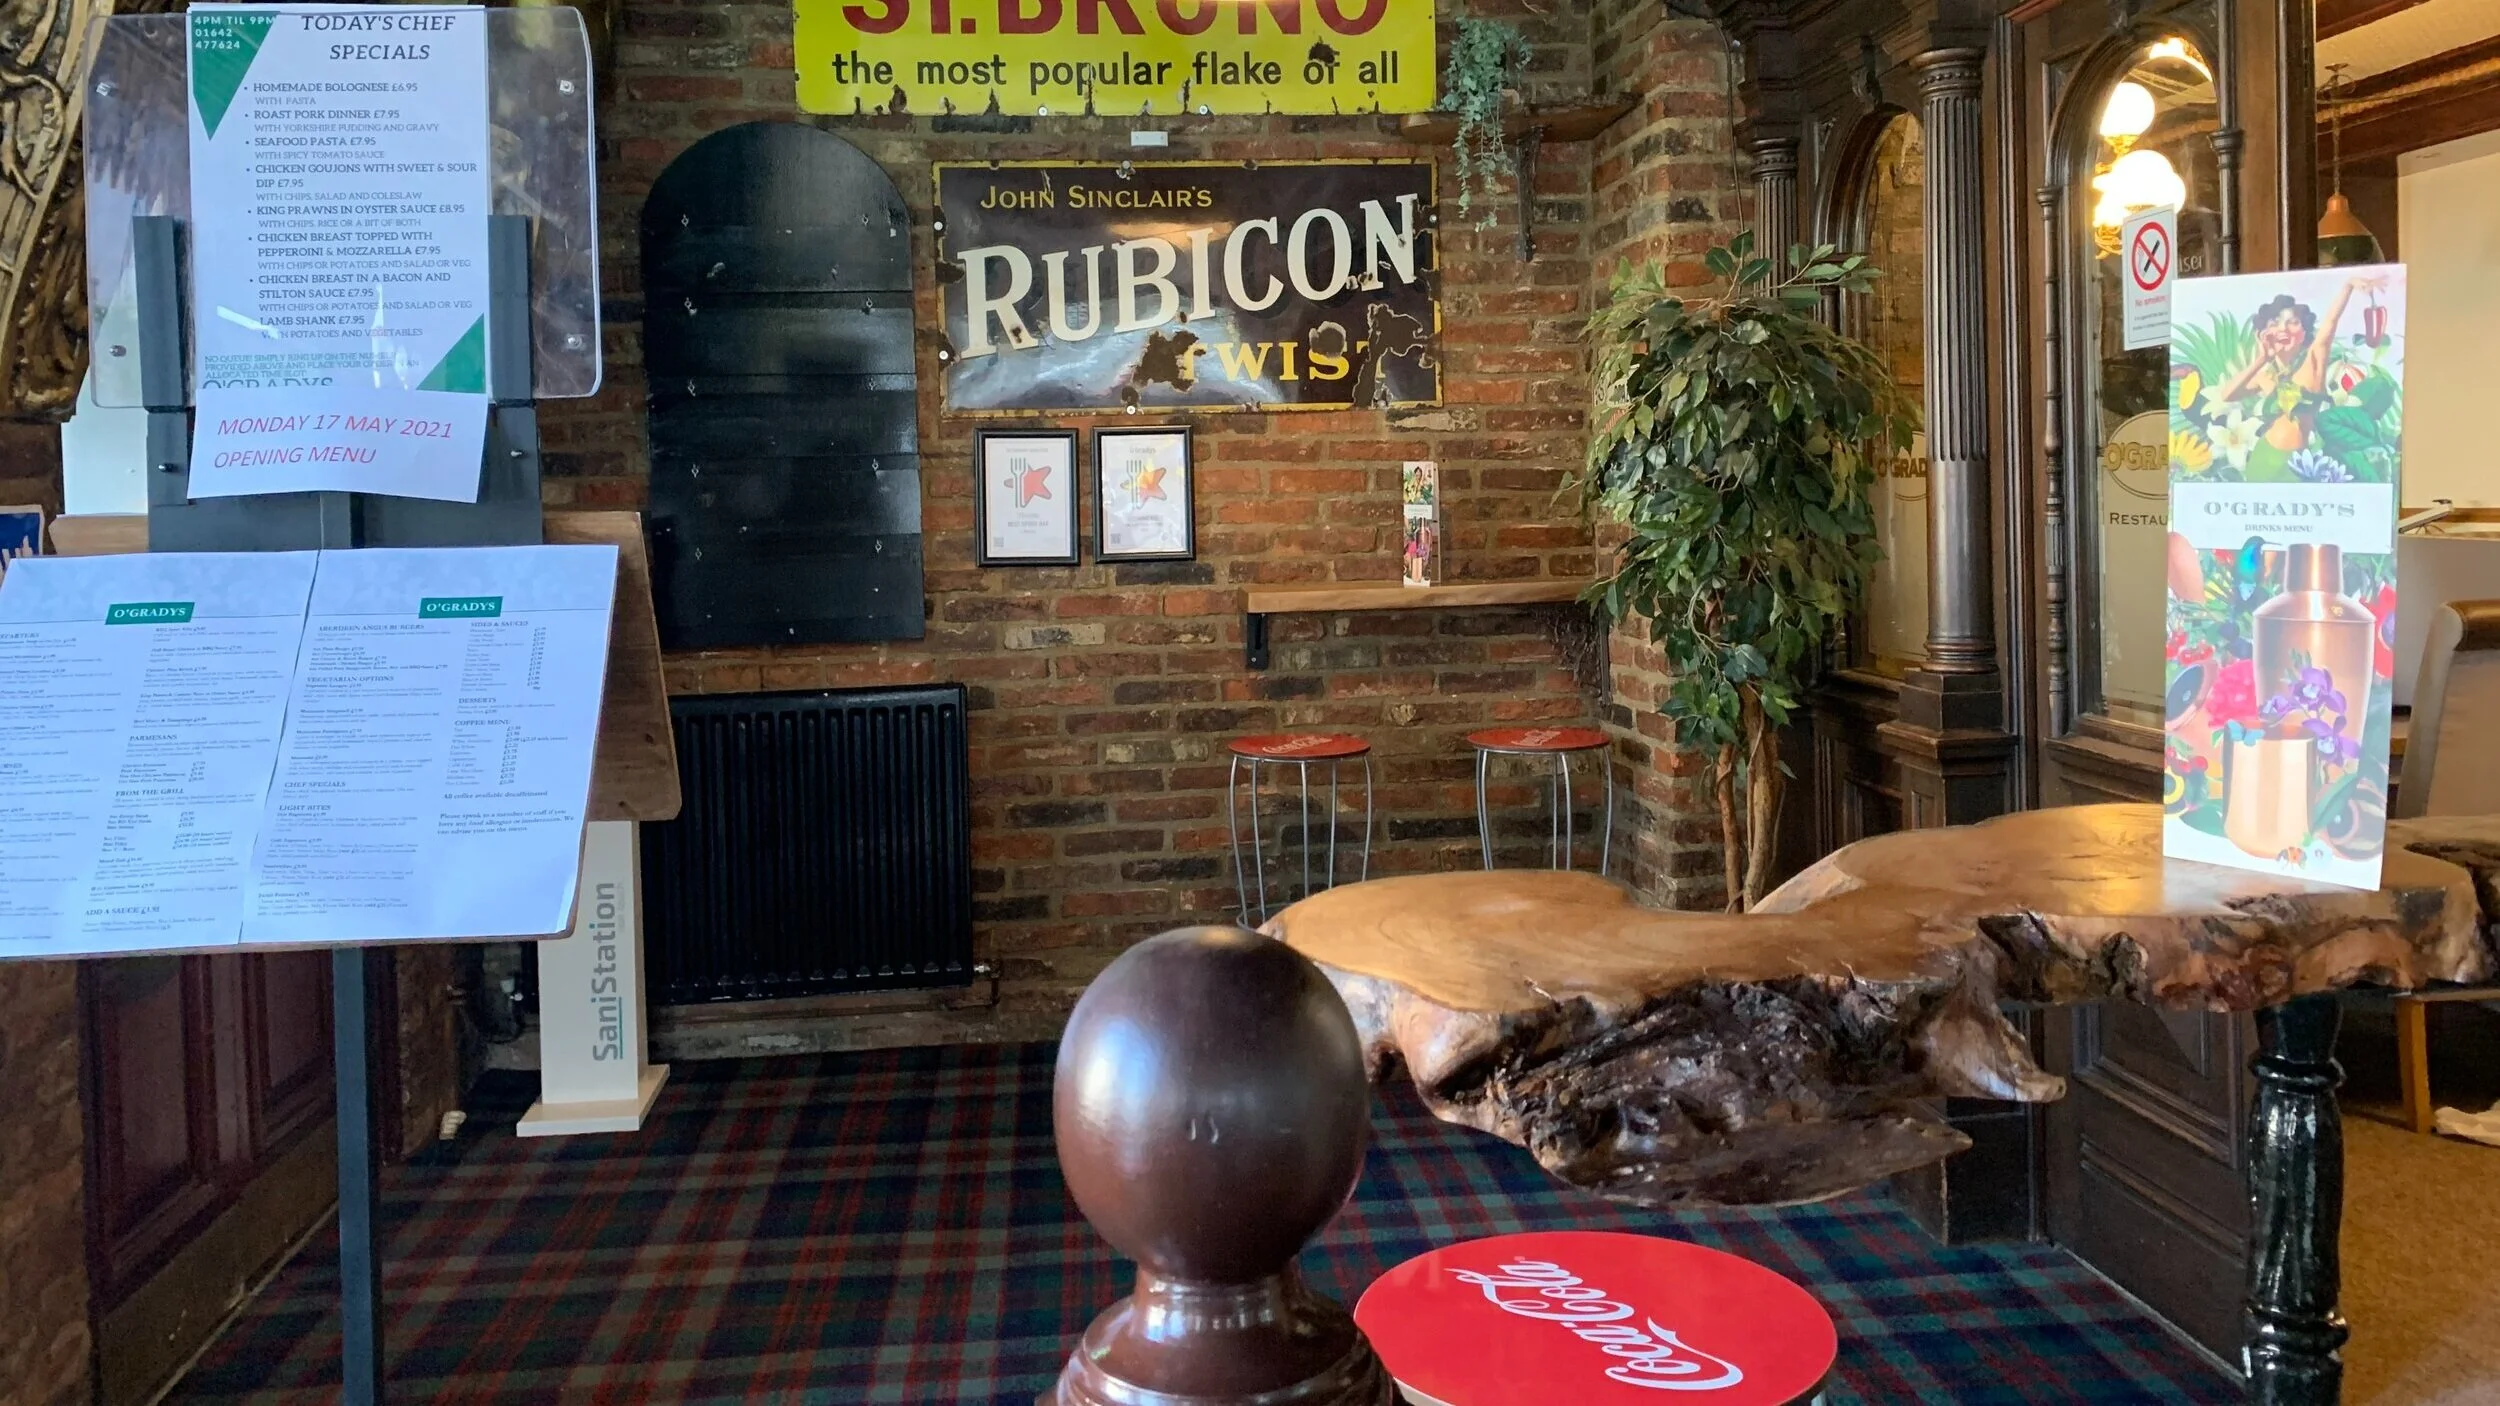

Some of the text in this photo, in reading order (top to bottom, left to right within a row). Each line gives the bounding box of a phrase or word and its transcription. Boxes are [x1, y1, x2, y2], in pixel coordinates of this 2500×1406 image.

[195, 16, 221, 25] 4PM
[226, 16, 245, 25] TIL
[301, 15, 457, 31] TODAY'S CHEF
[195, 28, 232, 37] 01642
[195, 40, 240, 49] 477624
[329, 44, 430, 60] SPECIALS
[832, 50, 1398, 96] the most popular flake of all
[253, 82, 418, 92] HOMEMADE BOLOGNESE £6.95
[255, 97, 282, 105] WITH
[254, 109, 400, 119] ROAST PORK DINNER £7.95
[254, 136, 376, 146] SEAFOOD PASTA £7.95
[255, 163, 477, 174] CHICKEN GOUJONS WITH SWEET & SOUR
[256, 178, 304, 188] DIP £7.95
[980, 184, 1213, 210] JOHN SINCLAIR'S
[257, 206, 285, 215] KING
[287, 206, 338, 215] PRAWNS
[340, 205, 352, 214] IN
[355, 205, 398, 214] OYSTER
[400, 204, 437, 214] SAUCE
[257, 231, 433, 242] CHICKEN BREAST TOPPED WITH
[326, 247, 334, 256] &
[336, 246, 412, 256] MOZZARELLA
[414, 246, 441, 255] £7.95
[258, 272, 451, 284] CHICKEN BREAST IN A BACON AND
[956, 192, 1419, 360] RUBICON
[259, 288, 374, 299] STILTON SAUCE £7.95
[260, 315, 365, 326] LAMB SHANK £7.95
[217, 413, 453, 439] MONDAY 17 MAY 2021
[213, 445, 377, 469] OPENING MENU
[2203, 501, 2356, 518] O'GRADY'S
[2245, 523, 2313, 533] DRINKS MENU
[114, 606, 187, 619] O'GRADYS
[426, 601, 496, 613] O'GRADYS
[588, 882, 618, 1062] SaniStation
[1444, 1255, 1744, 1391] Coca-Cola
